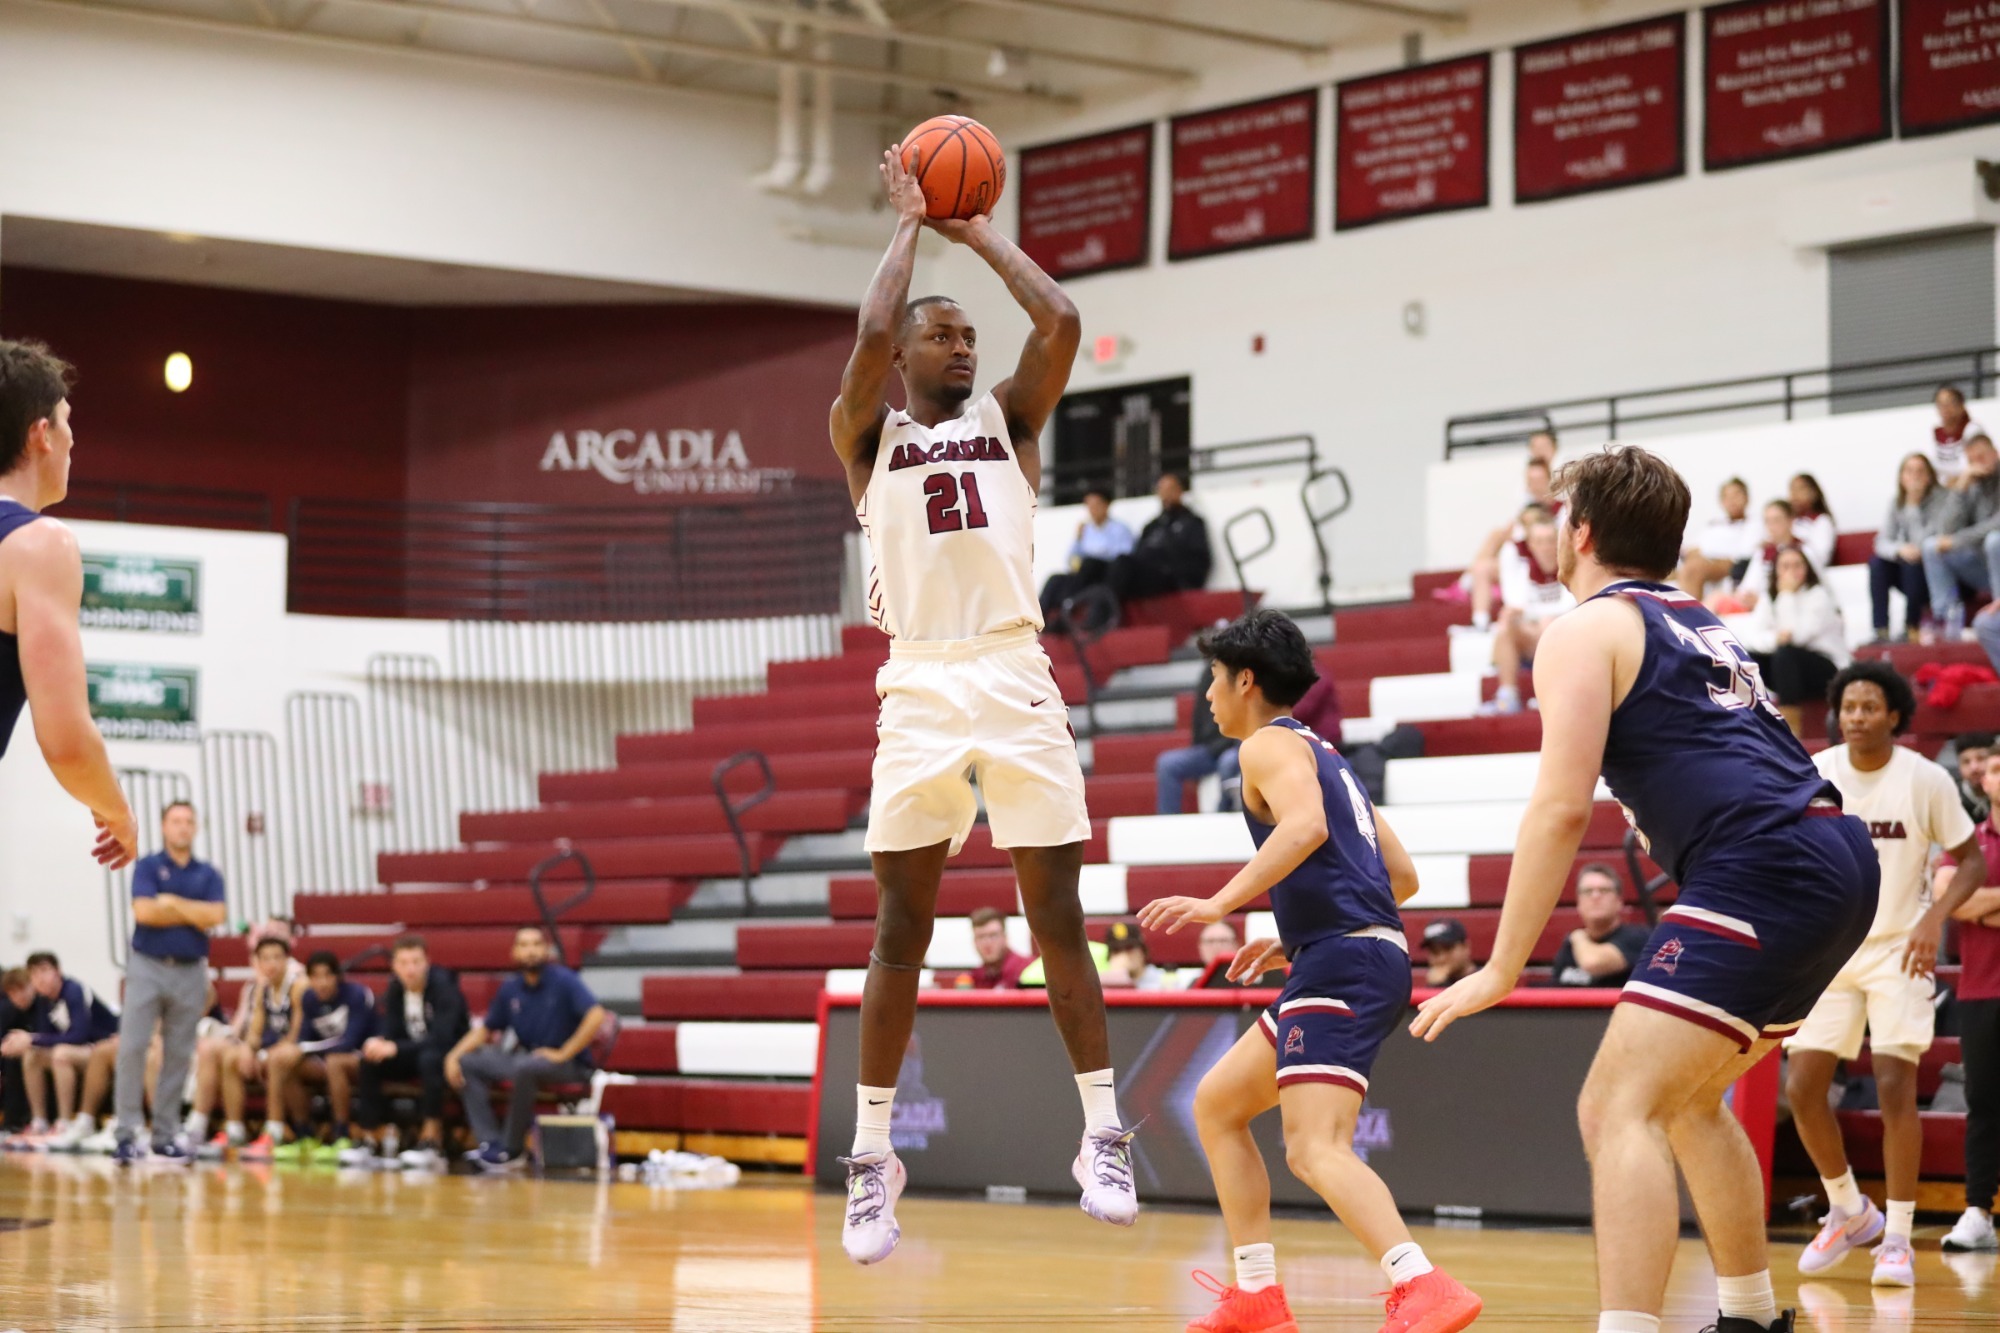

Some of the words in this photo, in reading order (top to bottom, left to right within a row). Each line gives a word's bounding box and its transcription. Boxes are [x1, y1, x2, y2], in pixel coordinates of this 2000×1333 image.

[540, 428, 749, 484] ARCADIA
[889, 436, 1010, 472] ARCADIA
[923, 472, 989, 535] 21
